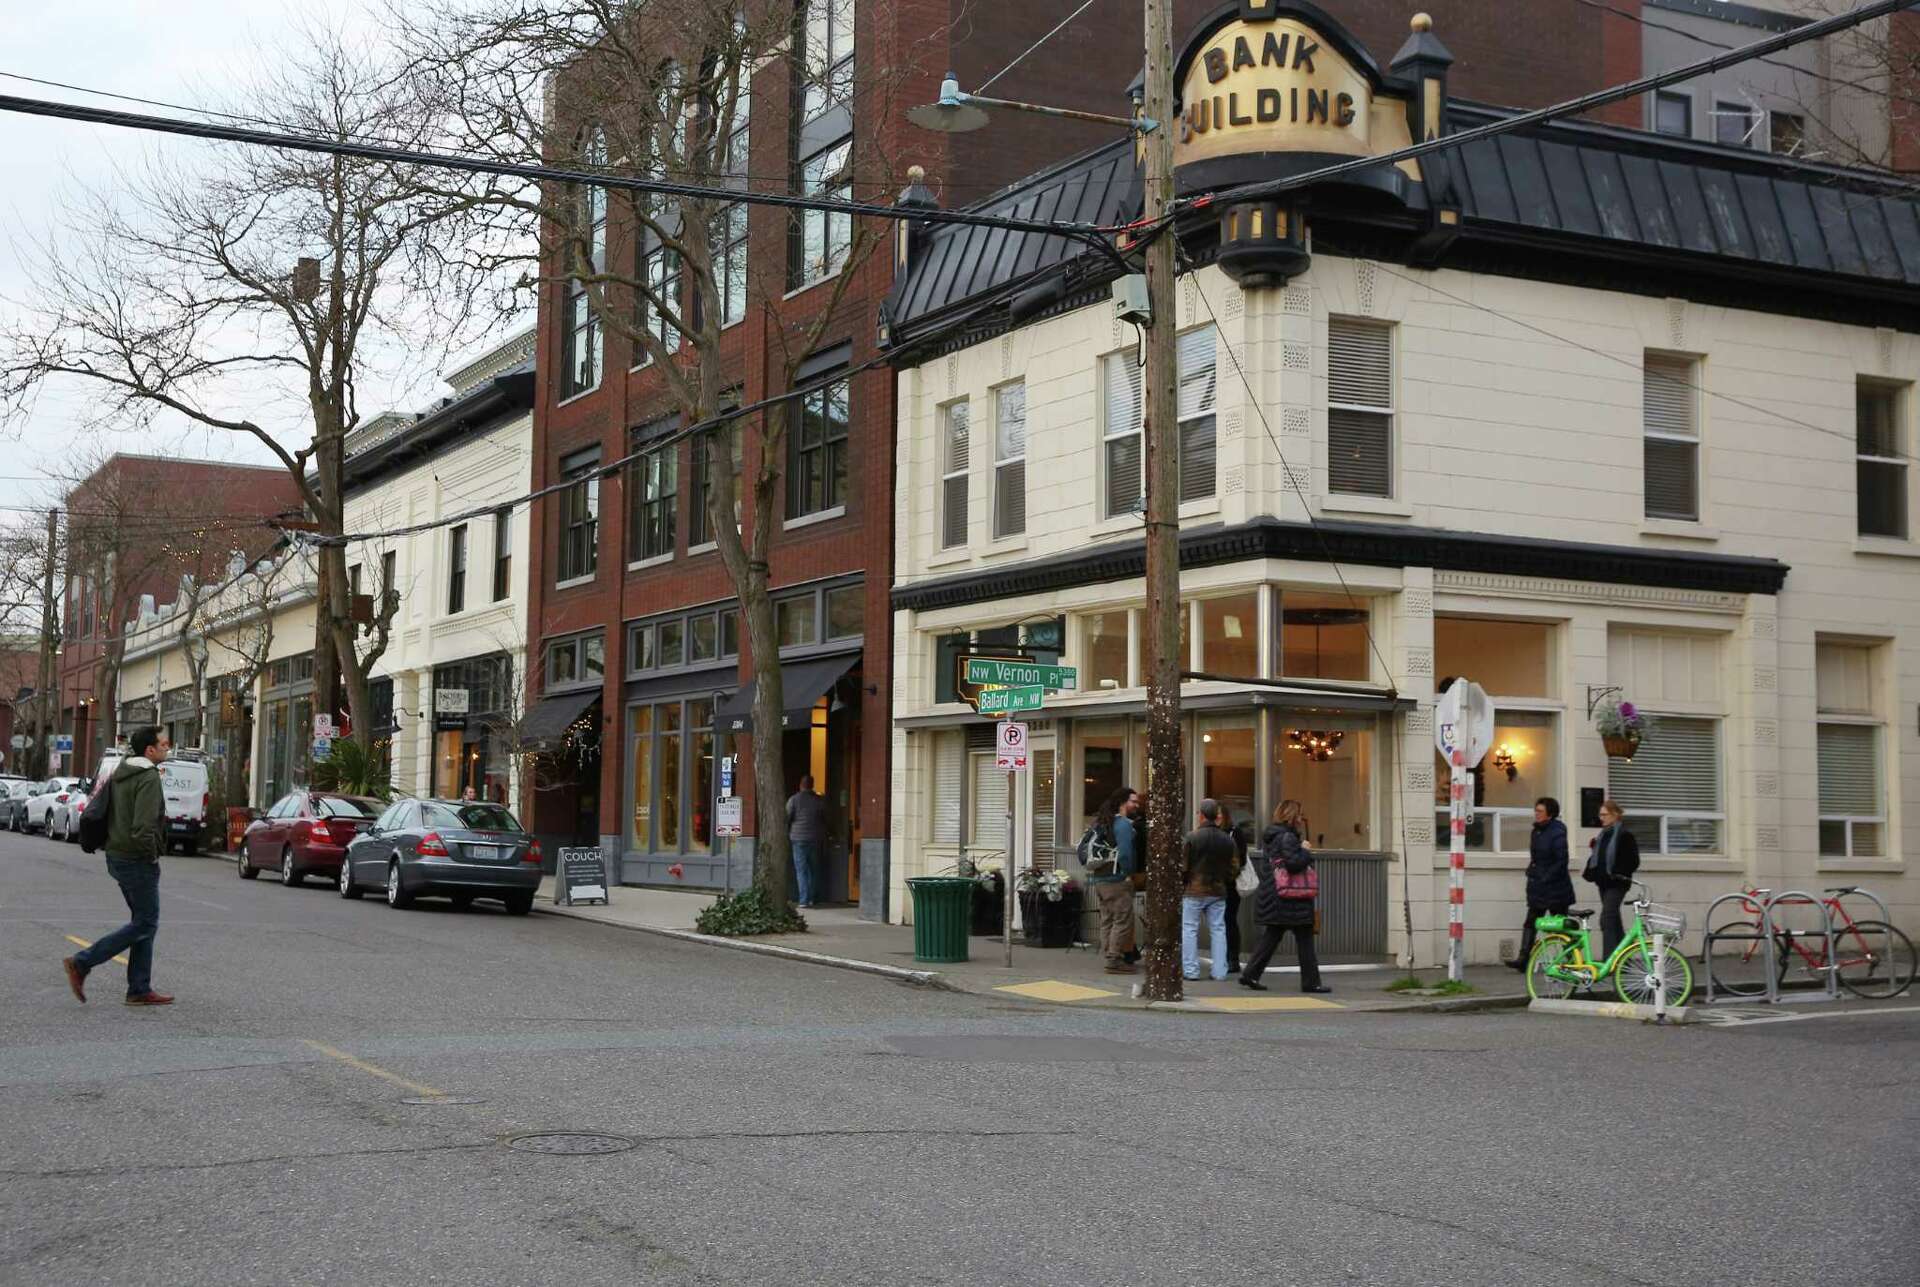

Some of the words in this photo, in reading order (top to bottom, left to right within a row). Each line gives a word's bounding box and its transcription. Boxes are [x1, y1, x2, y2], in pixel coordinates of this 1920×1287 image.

[1203, 31, 1320, 85] BANK
[1180, 87, 1356, 144] BUILDING
[971, 666, 990, 680] NW
[996, 663, 1040, 683] Vernon
[981, 692, 1009, 710] Ballard
[1012, 695, 1024, 707] Ave
[1029, 692, 1041, 705] NW
[564, 851, 602, 862] COUCH
